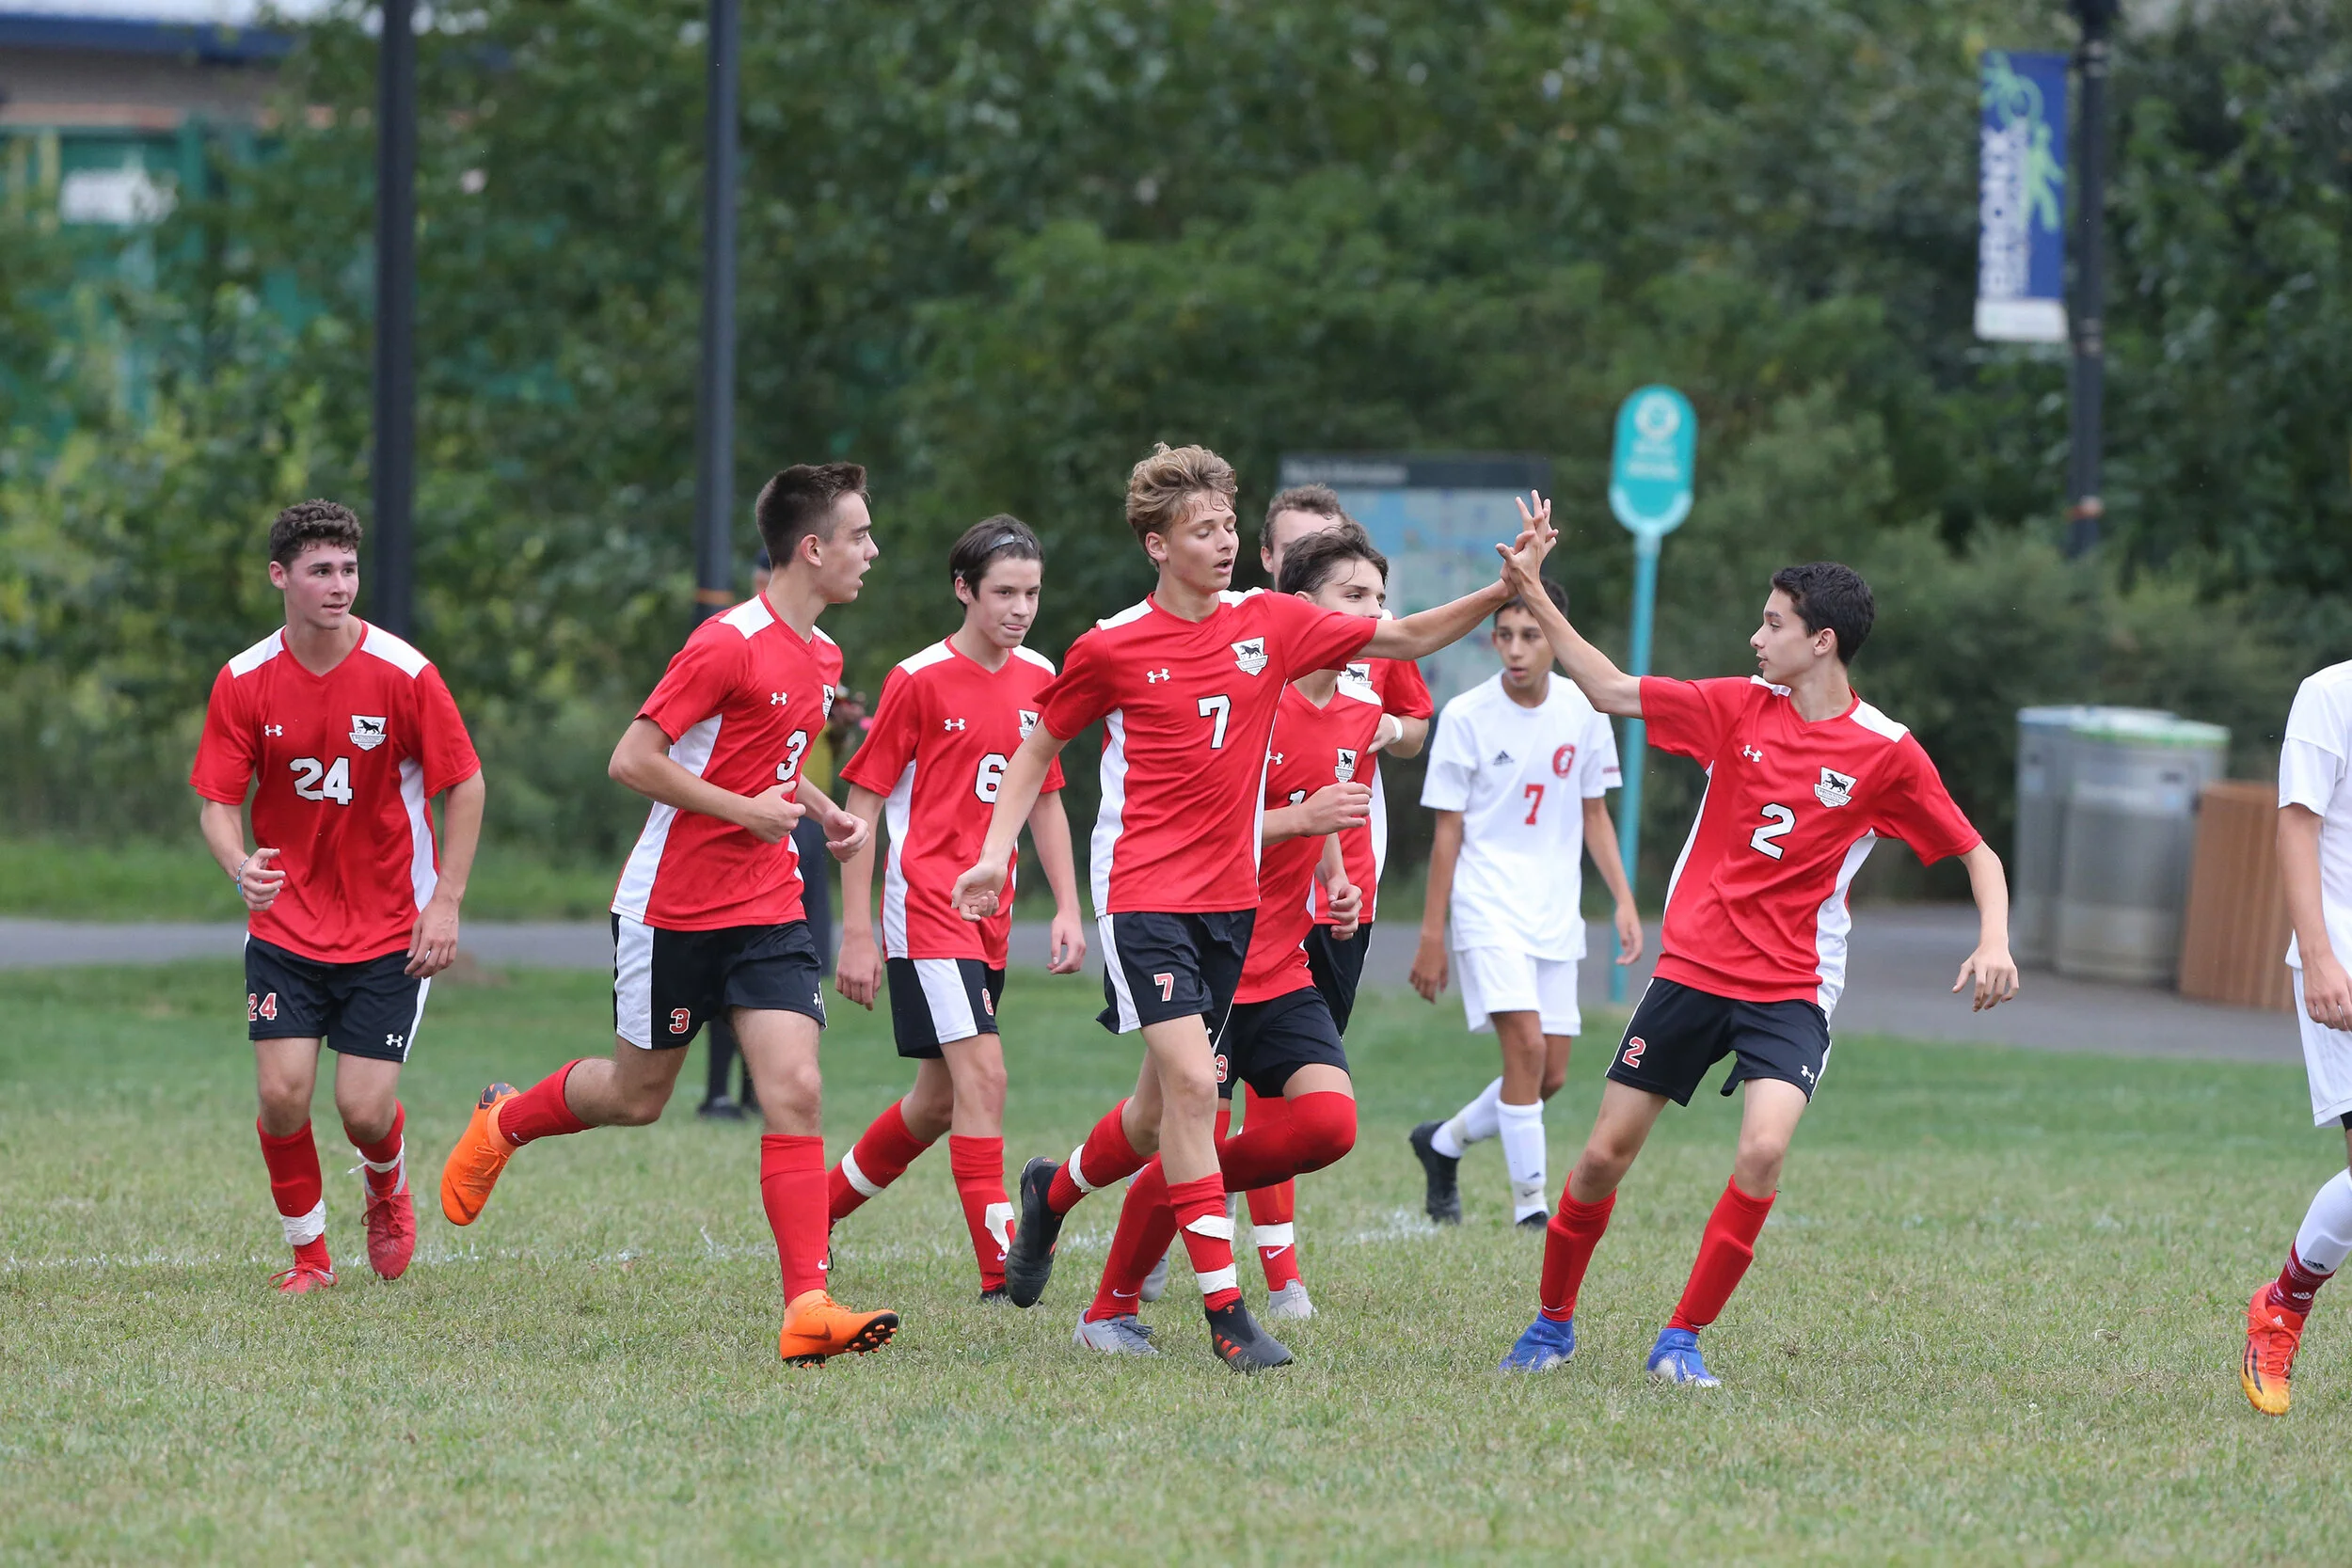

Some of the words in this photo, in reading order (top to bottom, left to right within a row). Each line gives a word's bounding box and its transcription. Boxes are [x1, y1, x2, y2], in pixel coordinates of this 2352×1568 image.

[1198, 694, 1232, 749] 7
[777, 730, 808, 782] 3
[975, 753, 1009, 804] 6
[289, 756, 354, 805] 24
[1524, 784, 1545, 825] 7
[1751, 803, 1797, 860] 2
[249, 992, 278, 1021] 24
[1153, 973, 1175, 1002] 7
[669, 1008, 691, 1035] 3
[1622, 1037, 1646, 1069] 2
